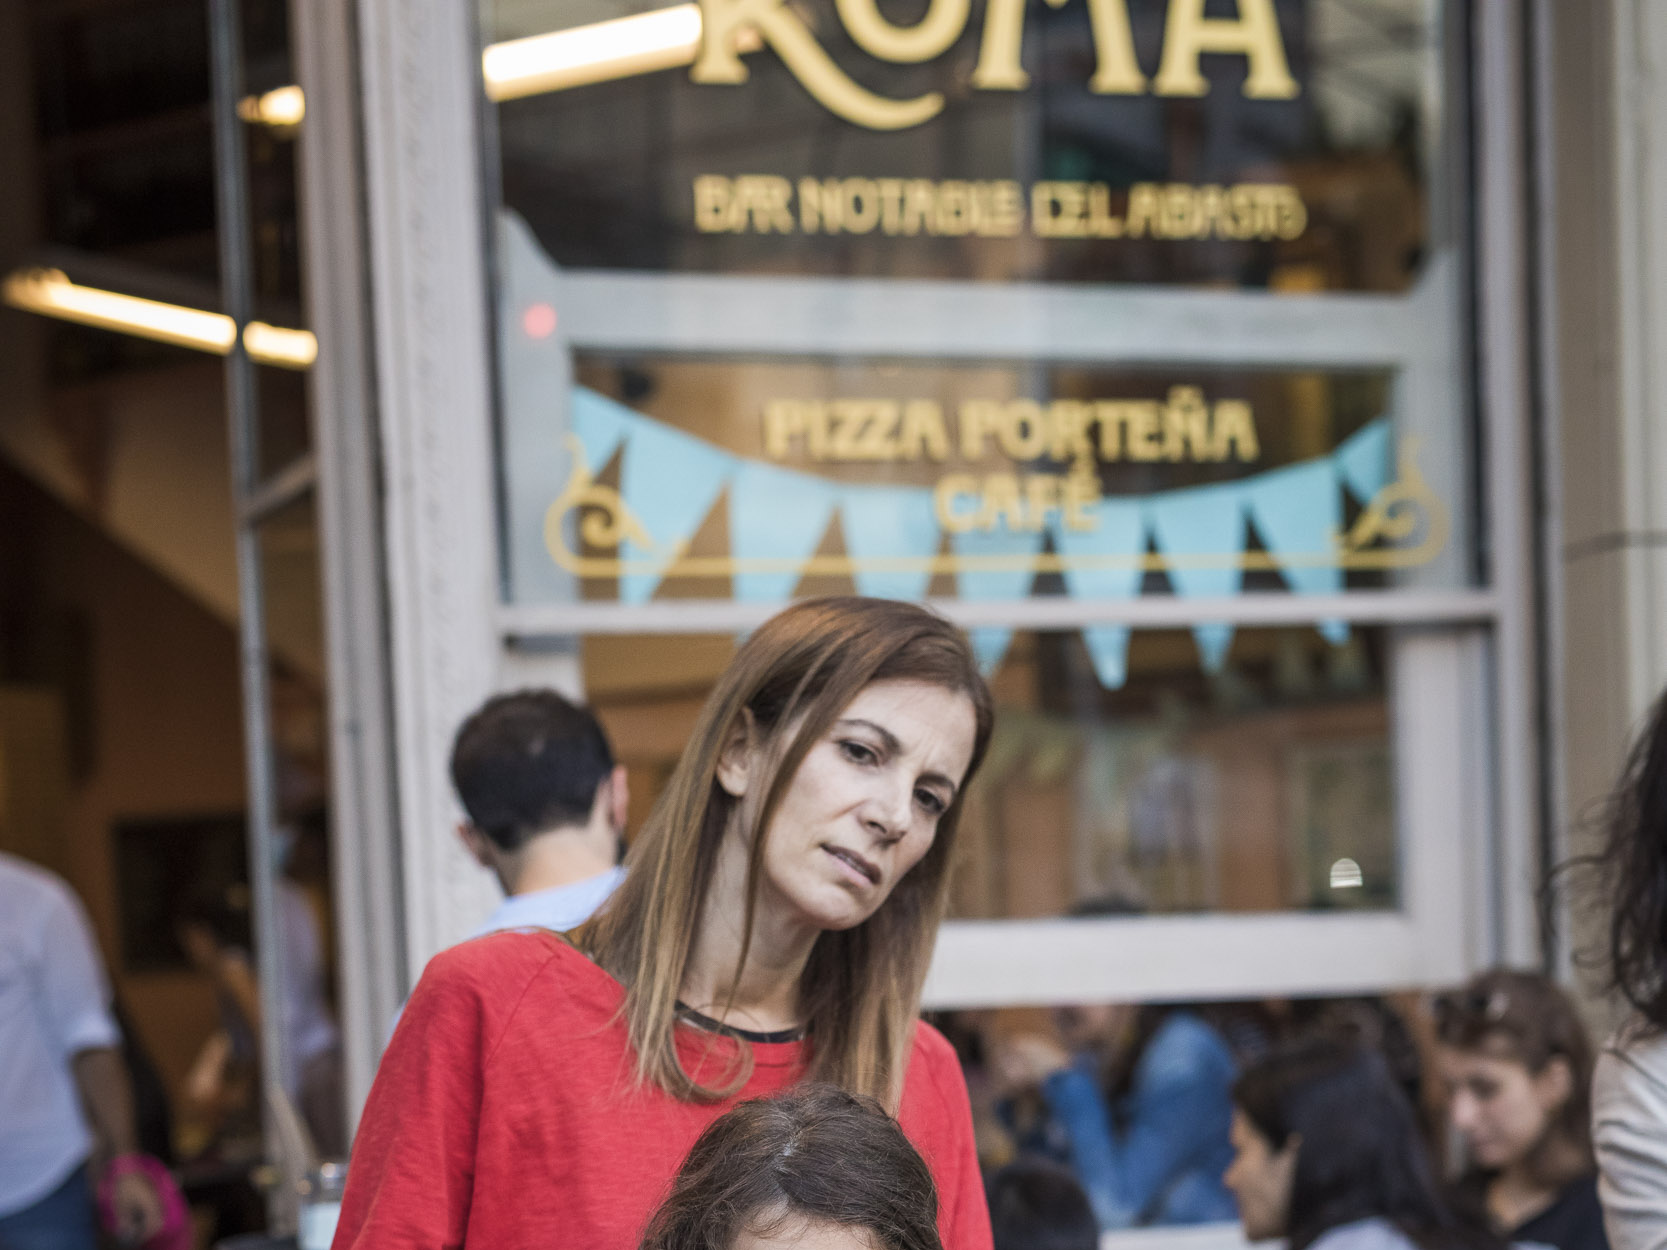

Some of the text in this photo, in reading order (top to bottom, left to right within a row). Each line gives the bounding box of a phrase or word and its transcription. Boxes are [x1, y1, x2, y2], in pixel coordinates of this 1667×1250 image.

[694, 174, 1308, 242] BAR NOTABLE DEL ABASTO
[765, 384, 1259, 463] PIZZA PORTEÑA
[934, 450, 1103, 534] CAFÉ
